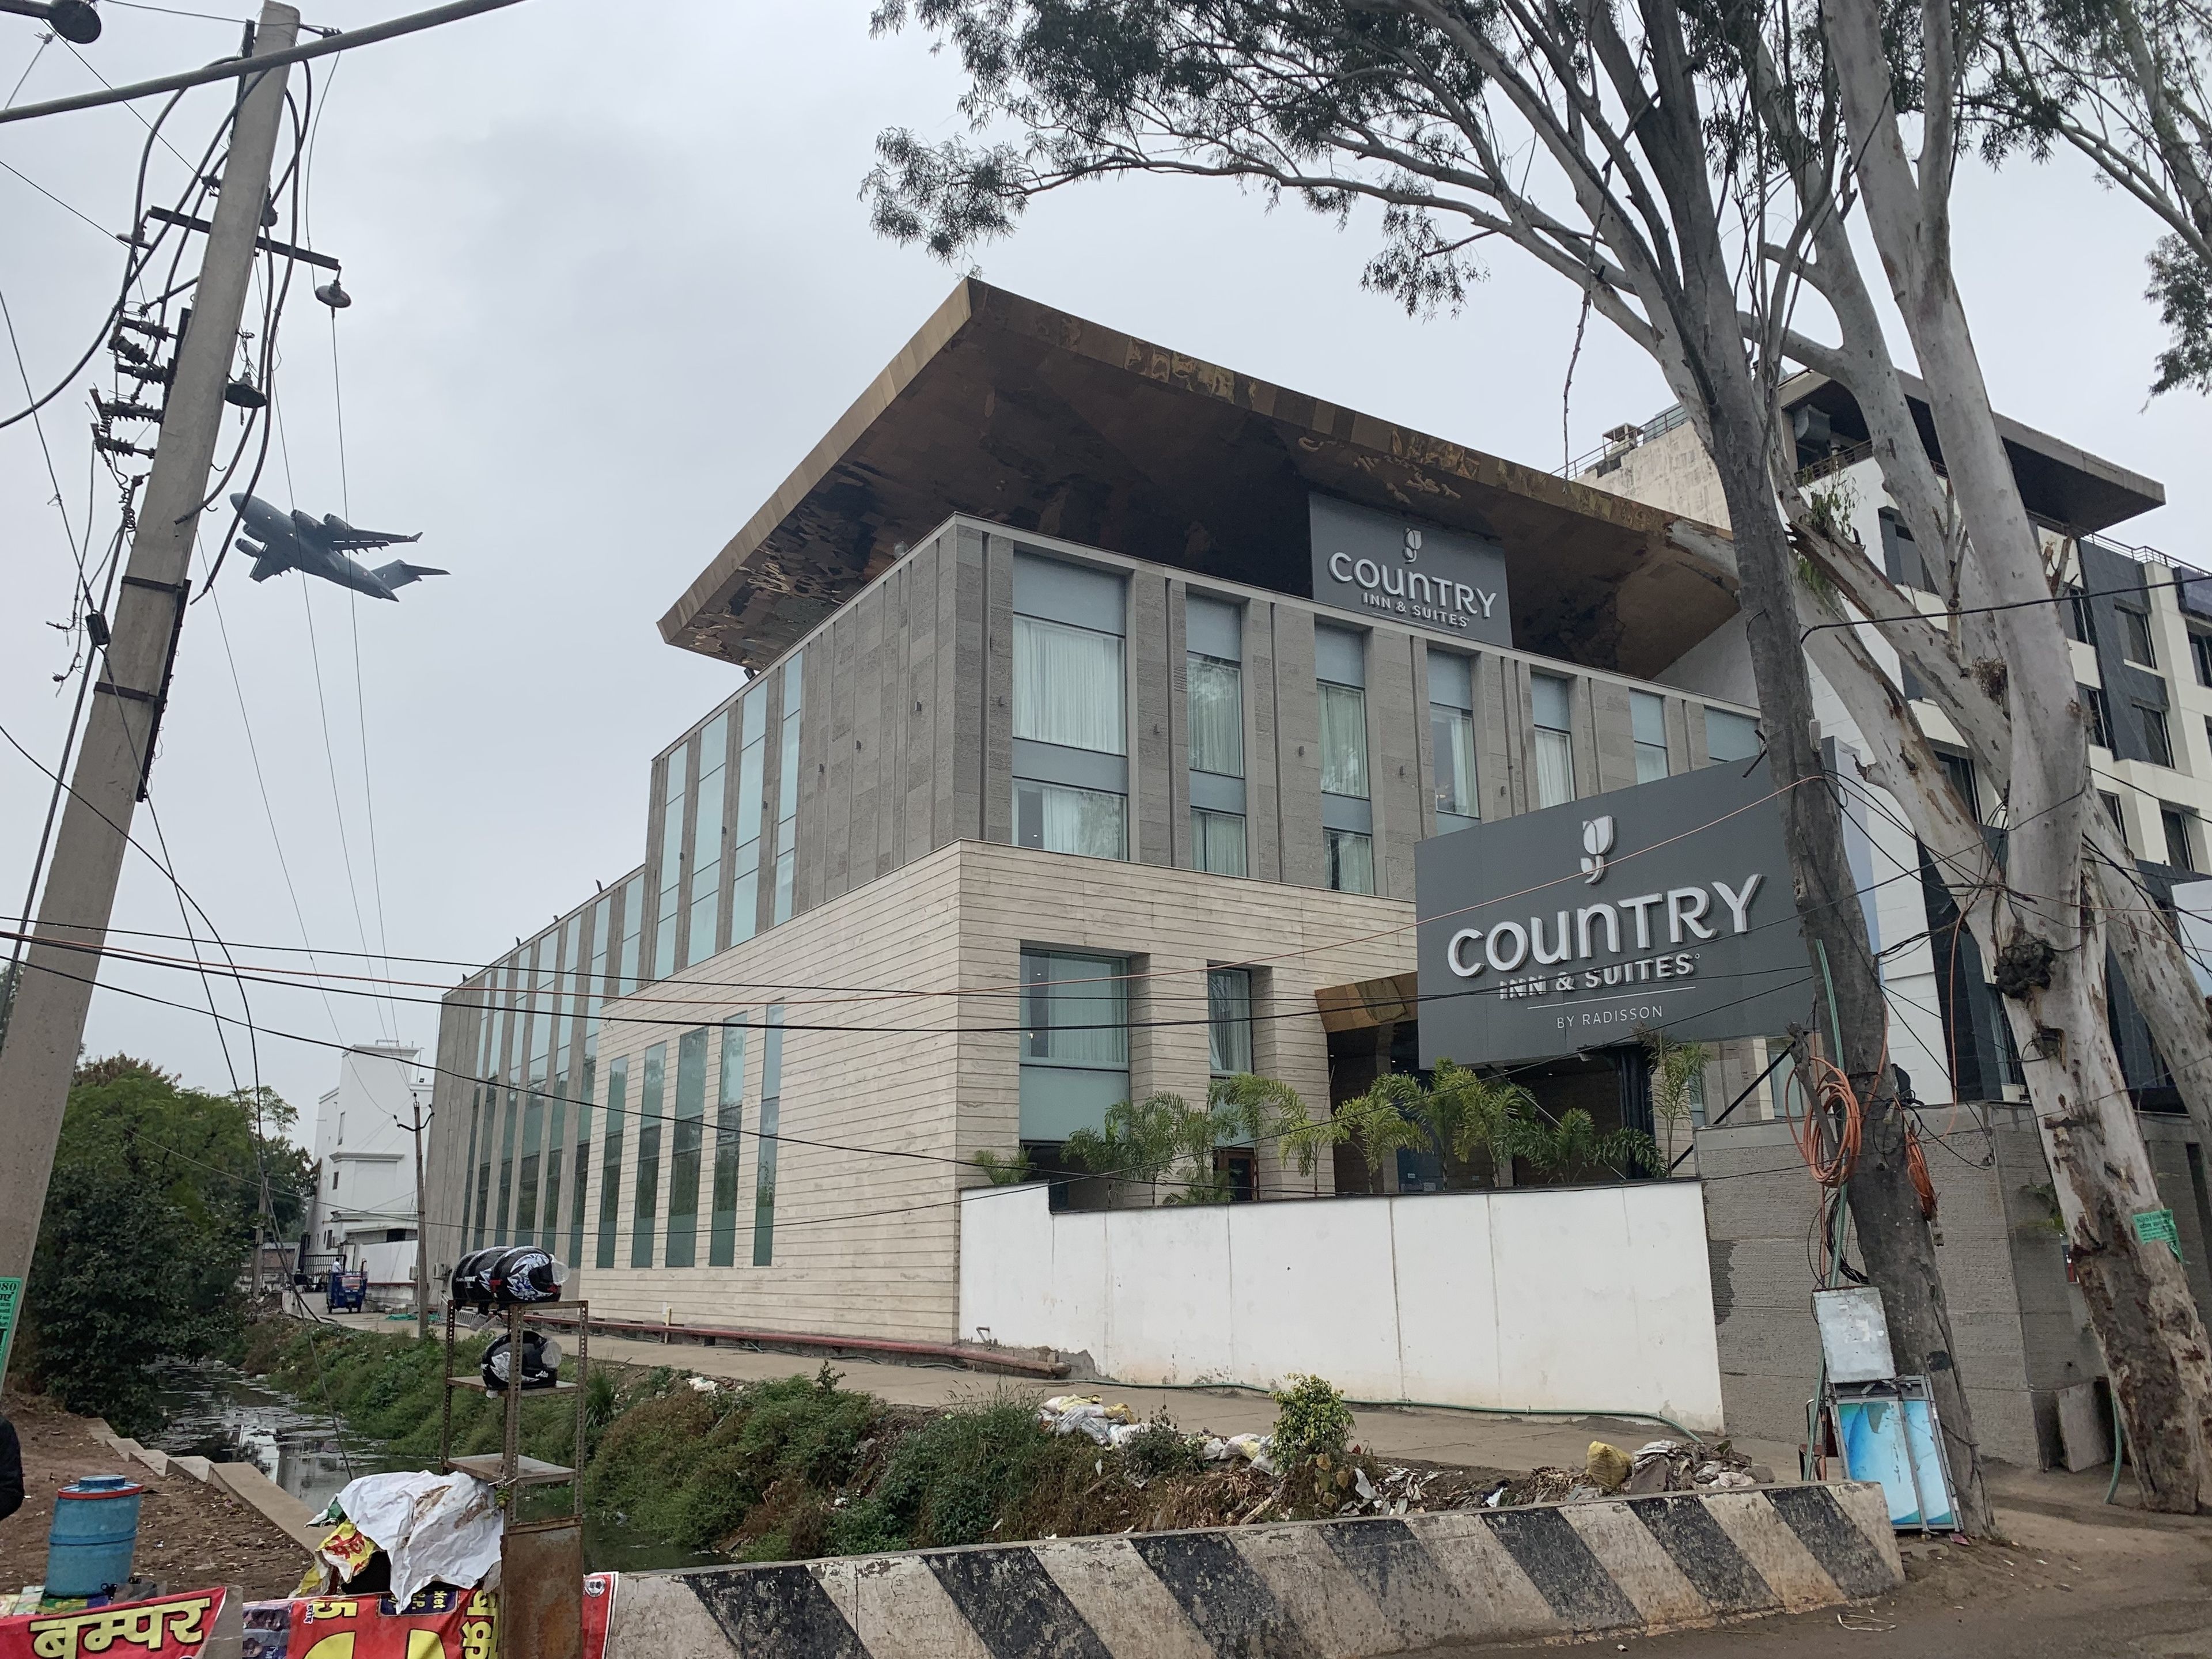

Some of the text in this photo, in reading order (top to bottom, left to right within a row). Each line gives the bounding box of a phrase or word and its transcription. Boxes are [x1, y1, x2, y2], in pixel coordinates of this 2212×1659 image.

[1362, 592, 1391, 609] INN
[1396, 601, 1407, 613] &
[1499, 974, 1547, 1001] INN
[1555, 971, 1576, 992] &
[1556, 1005, 1664, 1029] BY RADISSON
[29, 1597, 211, 1659] बम्पर
